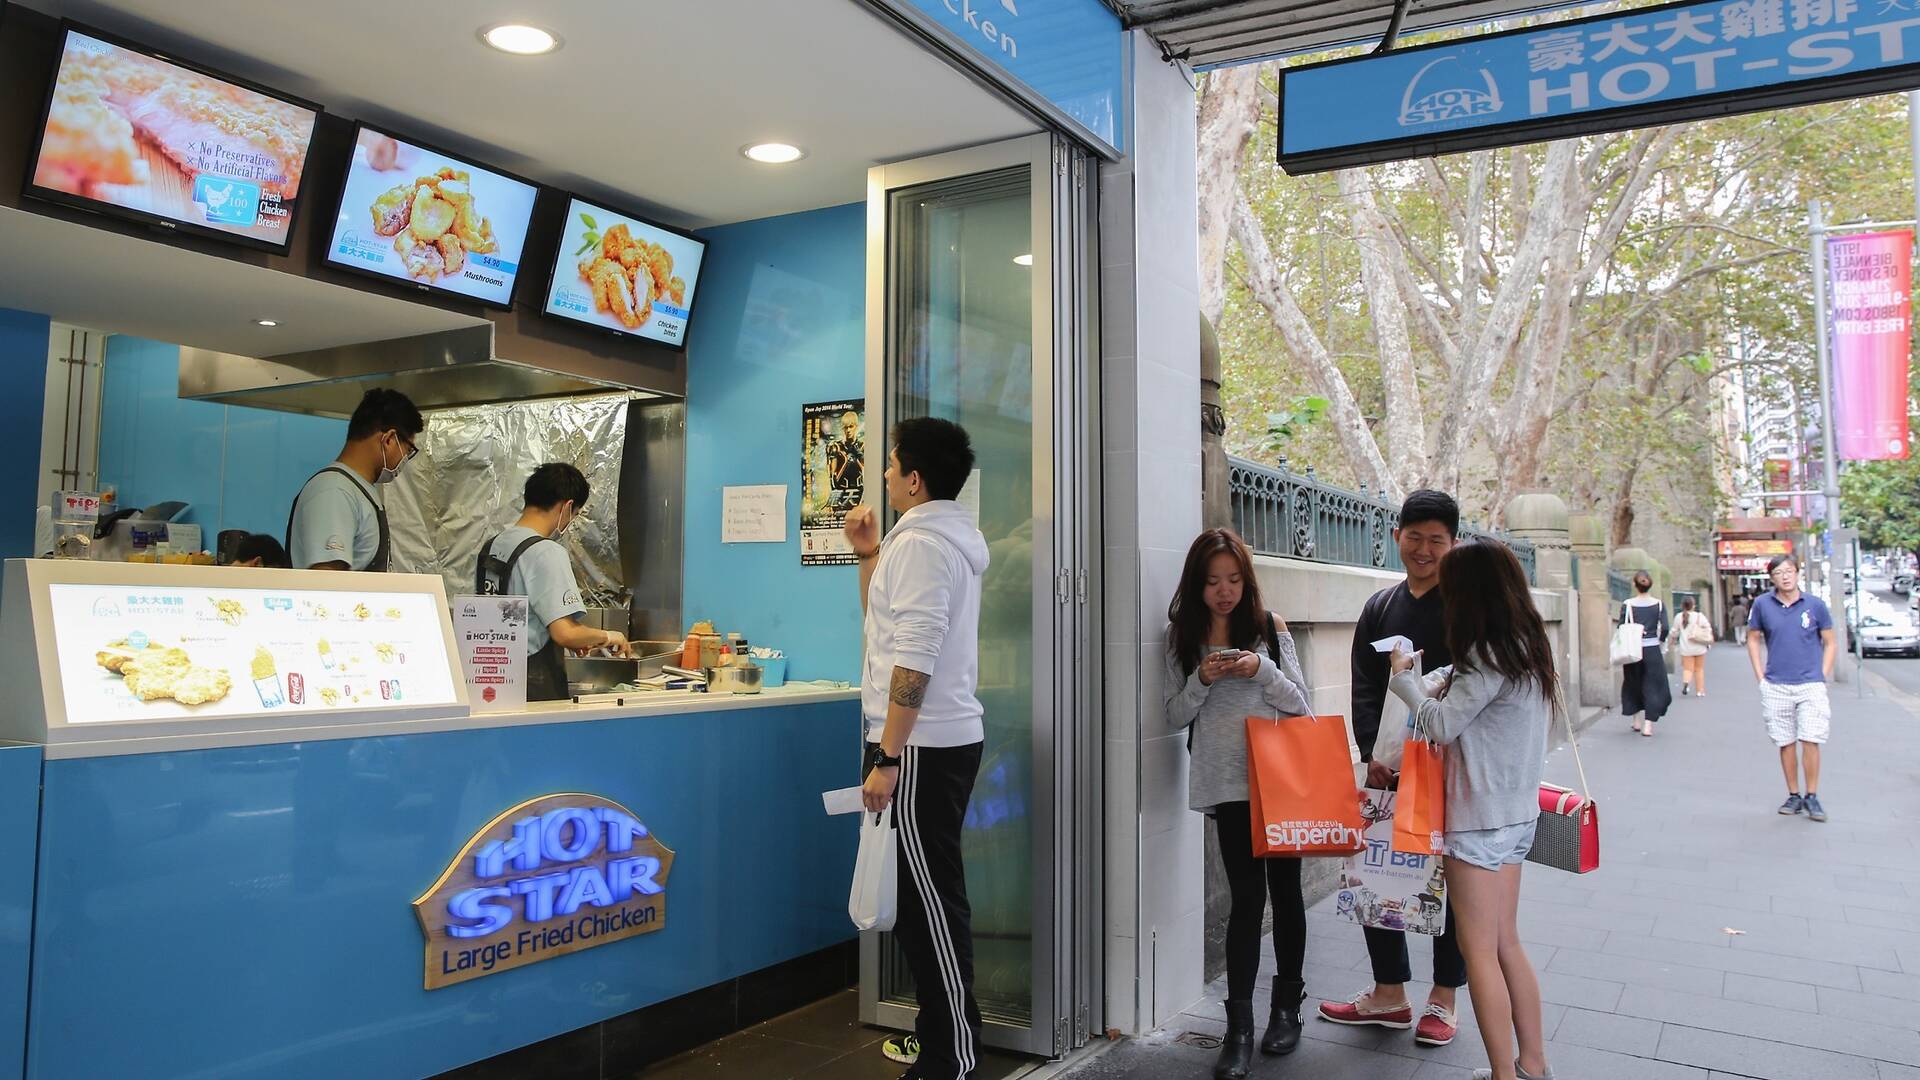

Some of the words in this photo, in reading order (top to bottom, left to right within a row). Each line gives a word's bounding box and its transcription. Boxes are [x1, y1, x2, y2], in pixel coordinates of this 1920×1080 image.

[1414, 90, 1489, 110] HOT
[1405, 101, 1494, 123] STAR
[200, 141, 212, 156] No
[215, 144, 276, 168] Preservatives
[197, 157, 210, 171] No
[213, 161, 253, 179] Artificial
[255, 167, 288, 185] Flavors
[230, 197, 248, 208] 100
[261, 188, 282, 203] Fresh
[260, 201, 288, 217] Chicken
[257, 214, 281, 229] Breast
[483, 256, 500, 268] $4.90
[463, 270, 504, 287] Mushrooms
[657, 320, 679, 331] Chicken
[474, 807, 649, 879] HOT
[1390, 851, 1430, 870] Bar
[444, 856, 665, 939] STAR
[443, 940, 511, 975] Large
[517, 920, 574, 956] Fried
[577, 905, 656, 940] Chicken
